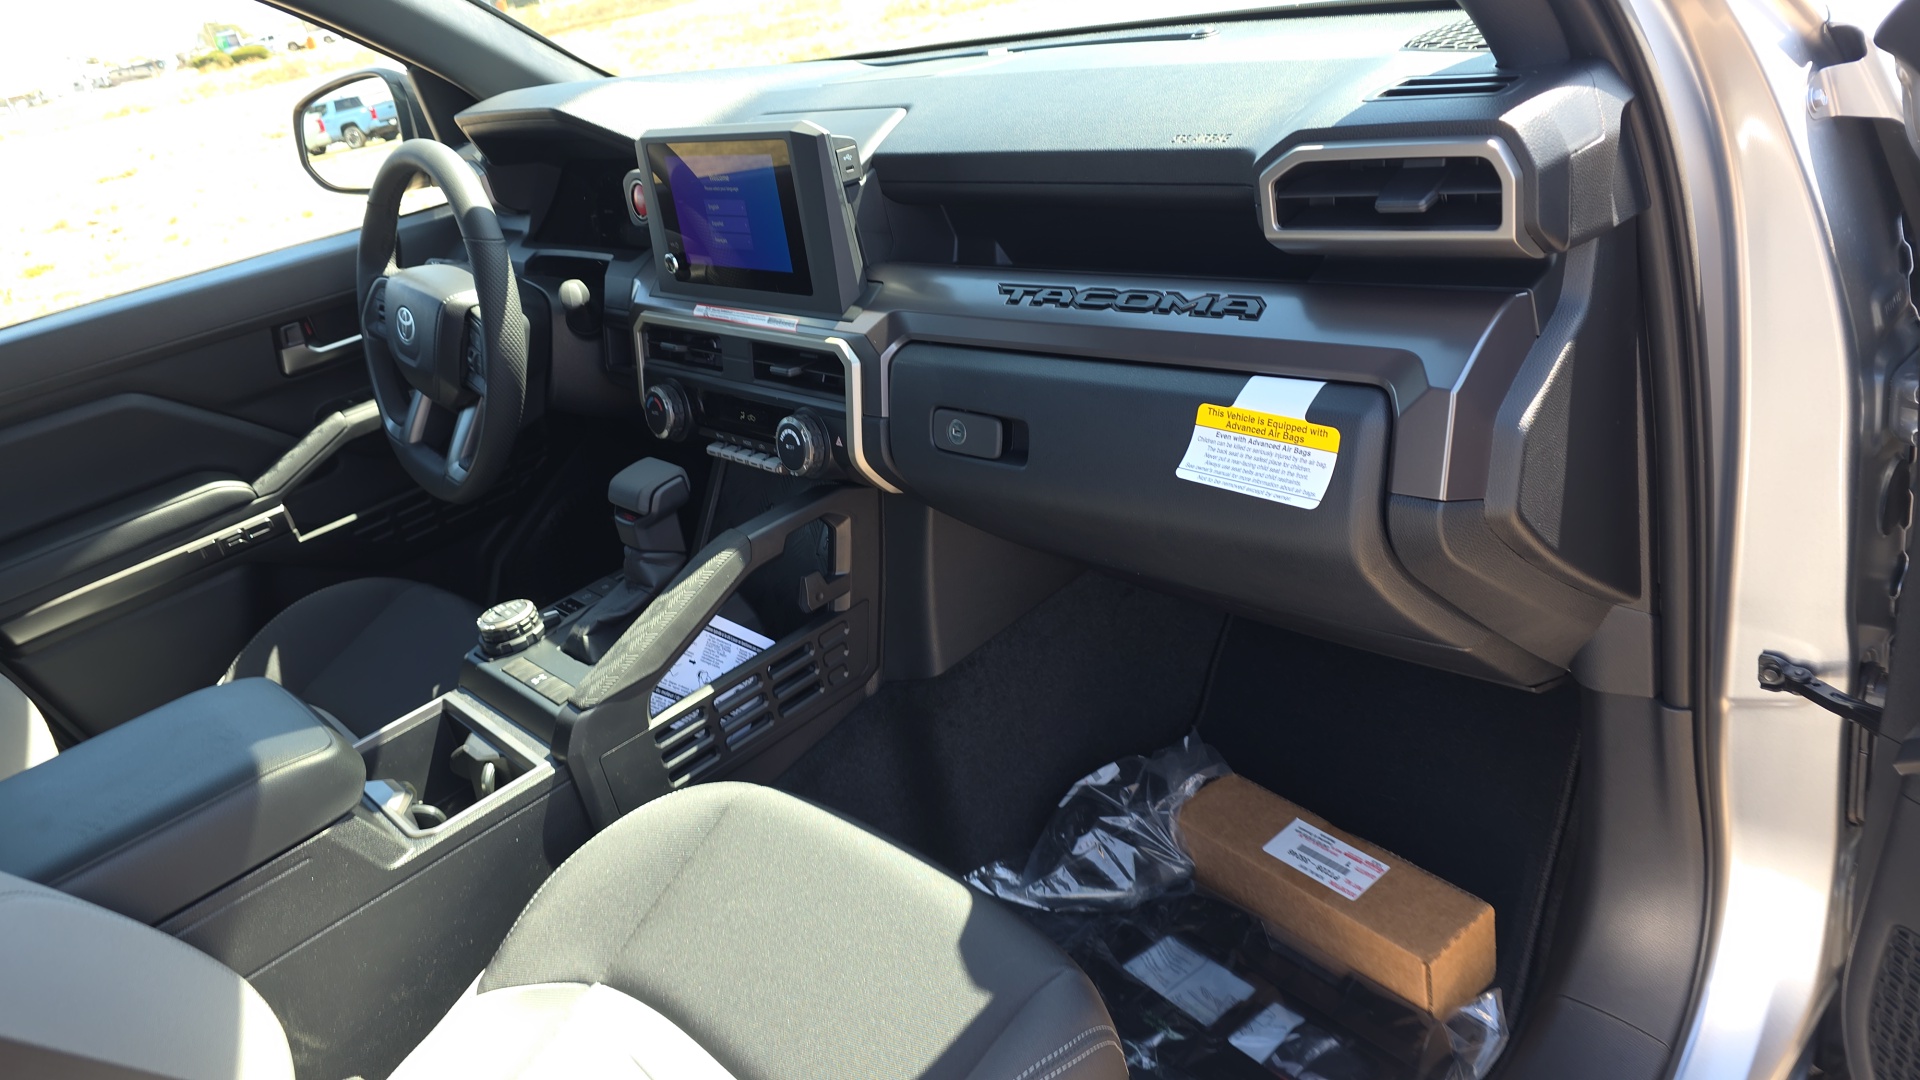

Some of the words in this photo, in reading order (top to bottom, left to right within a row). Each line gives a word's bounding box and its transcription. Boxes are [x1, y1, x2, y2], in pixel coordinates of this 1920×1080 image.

[998, 283, 1267, 322] TACOMA
[1208, 407, 1225, 418] This
[1227, 411, 1256, 424] Vehicle
[1257, 416, 1265, 426] is
[1267, 418, 1308, 434] Equipped
[1310, 428, 1329, 438] with
[1225, 421, 1267, 436] Advanced
[1267, 429, 1281, 438] Air
[1282, 431, 1305, 444] Bags
[1197, 435, 1217, 444] Children
[1233, 443, 1247, 451] killed
[1252, 448, 1274, 457] seriously
[1274, 451, 1291, 460] injured
[1215, 431, 1232, 440] Even
[1247, 438, 1281, 450] Advanced
[1282, 445, 1292, 453] Air
[1293, 447, 1311, 457] Bags
